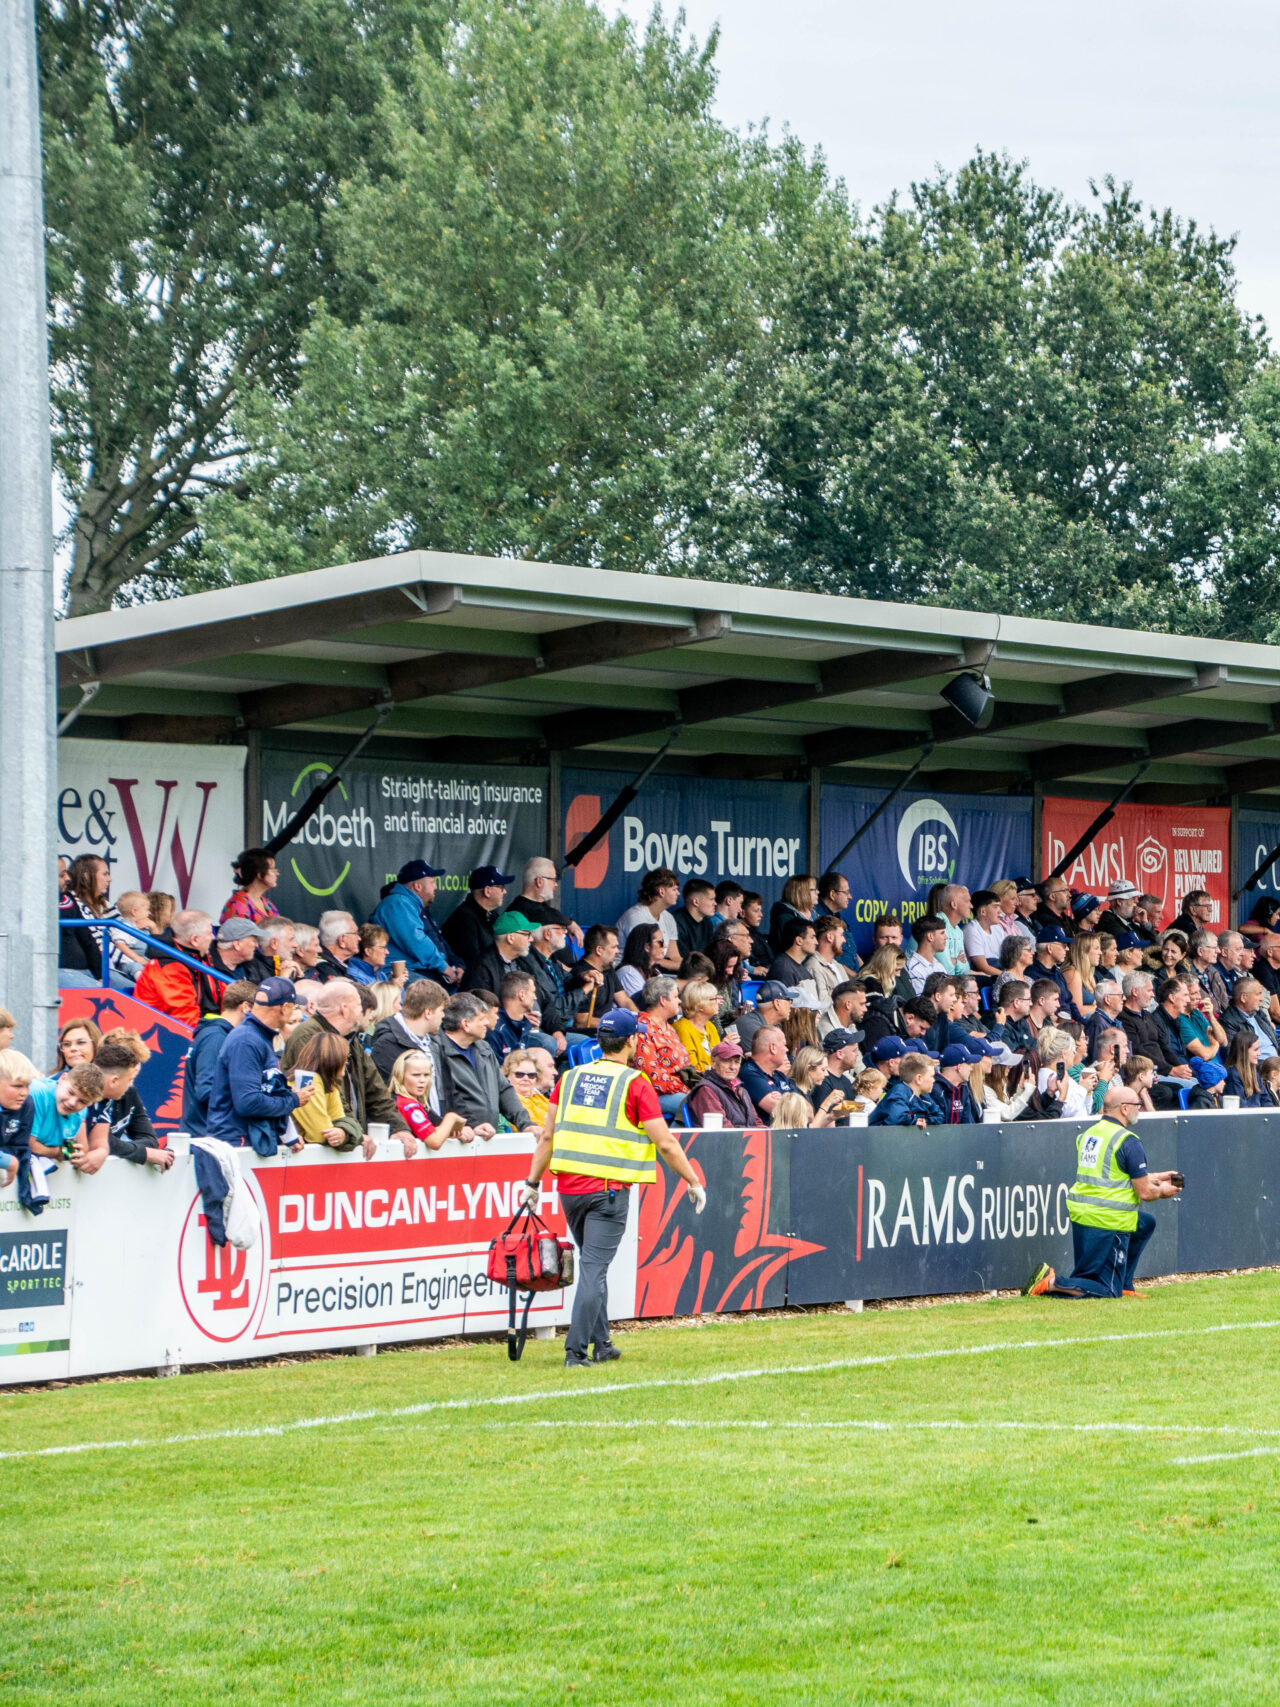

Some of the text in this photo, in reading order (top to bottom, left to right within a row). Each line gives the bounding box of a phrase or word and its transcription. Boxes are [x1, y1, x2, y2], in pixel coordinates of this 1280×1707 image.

[381, 776, 543, 806] Straight-talking insurance
[384, 810, 507, 835] and financial advice
[623, 816, 800, 877] Boyes Turner
[917, 834, 948, 872] IBS
[1190, 849, 1222, 873] INJURED
[1174, 874, 1207, 898] PLAYERS
[855, 899, 928, 924] COPY PRIN
[580, 1082, 605, 1091] MEDICAL
[583, 1074, 607, 1084] RAMS
[278, 1179, 559, 1234] DUNCAN-LYNCH
[981, 1182, 1070, 1241] RUGBY.C
[0, 1242, 62, 1273] cARDLE
[278, 1269, 529, 1316] Precision Enginee
